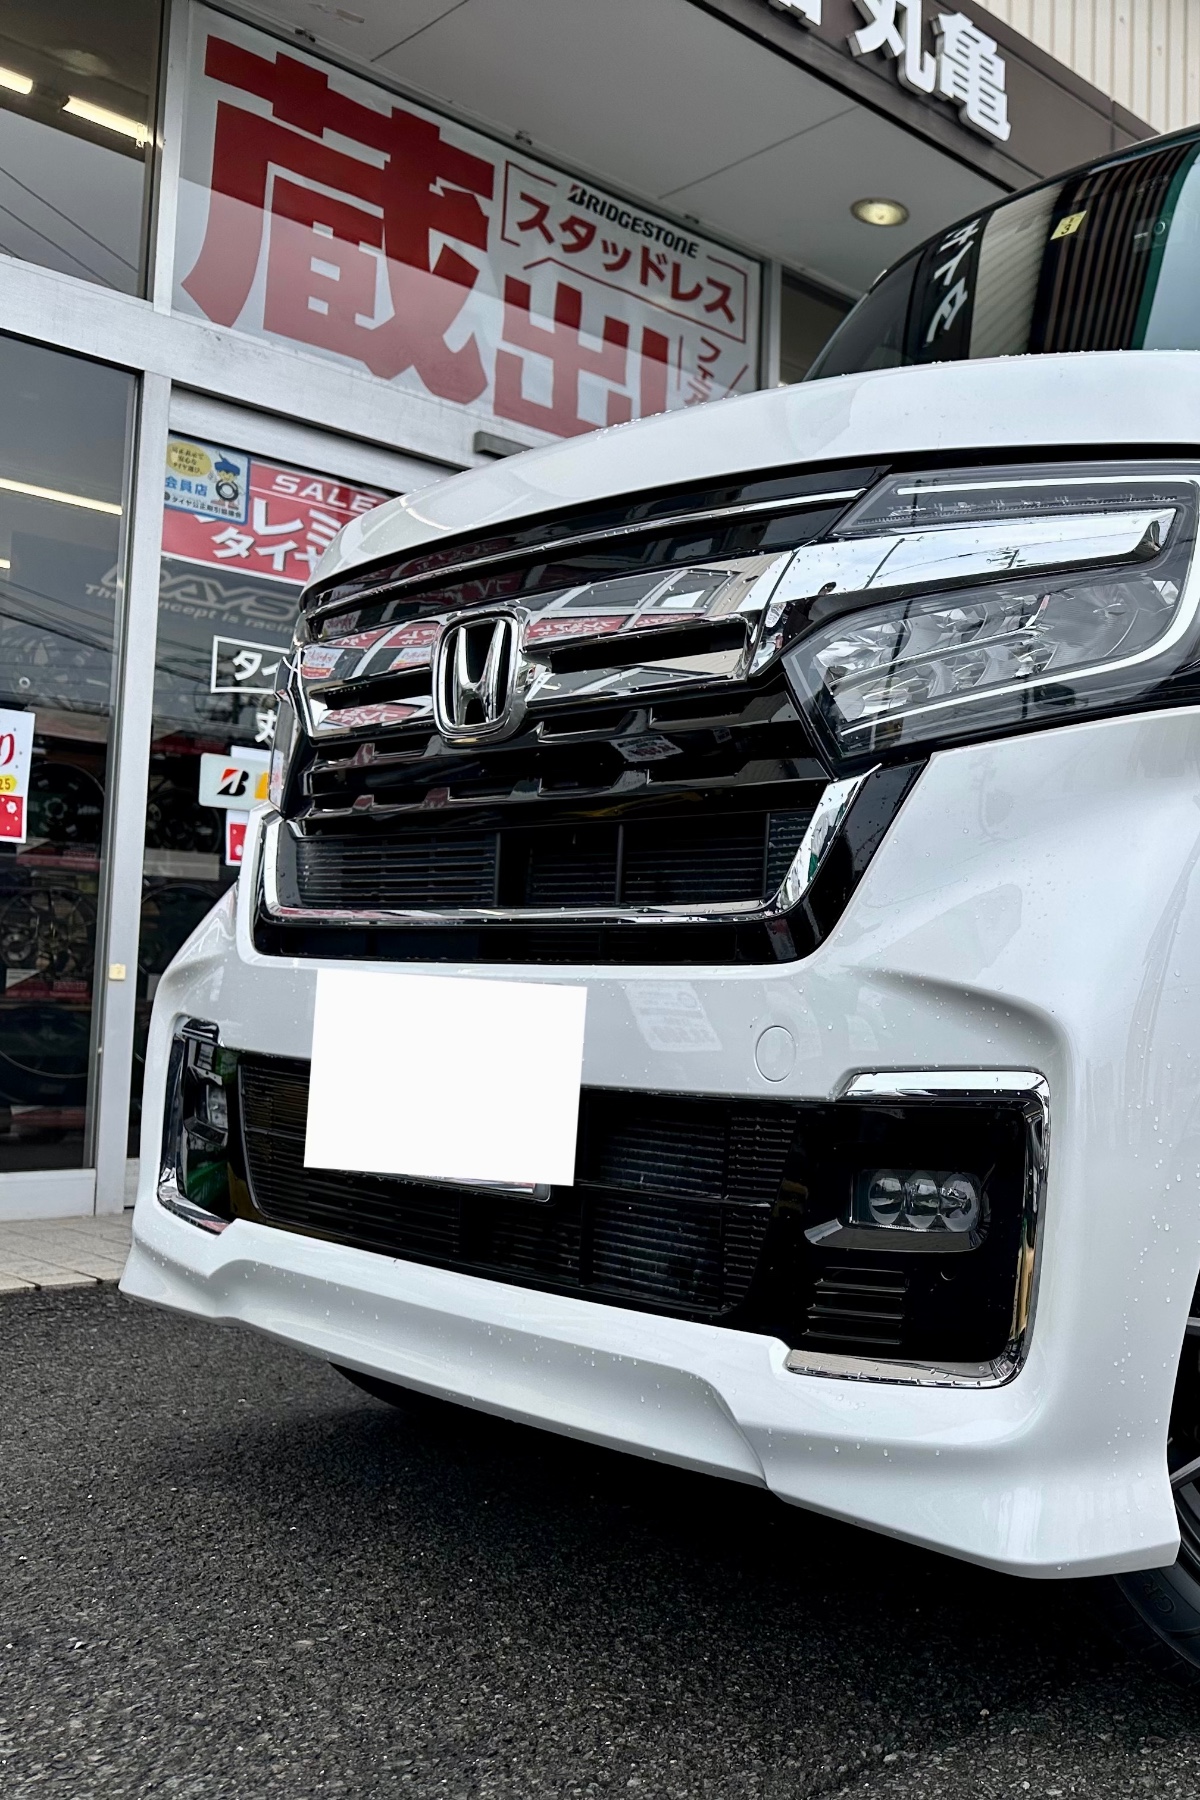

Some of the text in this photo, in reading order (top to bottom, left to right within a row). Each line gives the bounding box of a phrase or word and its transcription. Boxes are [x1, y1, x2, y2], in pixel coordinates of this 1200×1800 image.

[854, 0, 1012, 142] 丸亀
[517, 191, 736, 324] スタッドレス
[567, 184, 700, 259] BRIDGESTONE
[165, 476, 208, 497] 会員店
[272, 474, 378, 514] SALE
